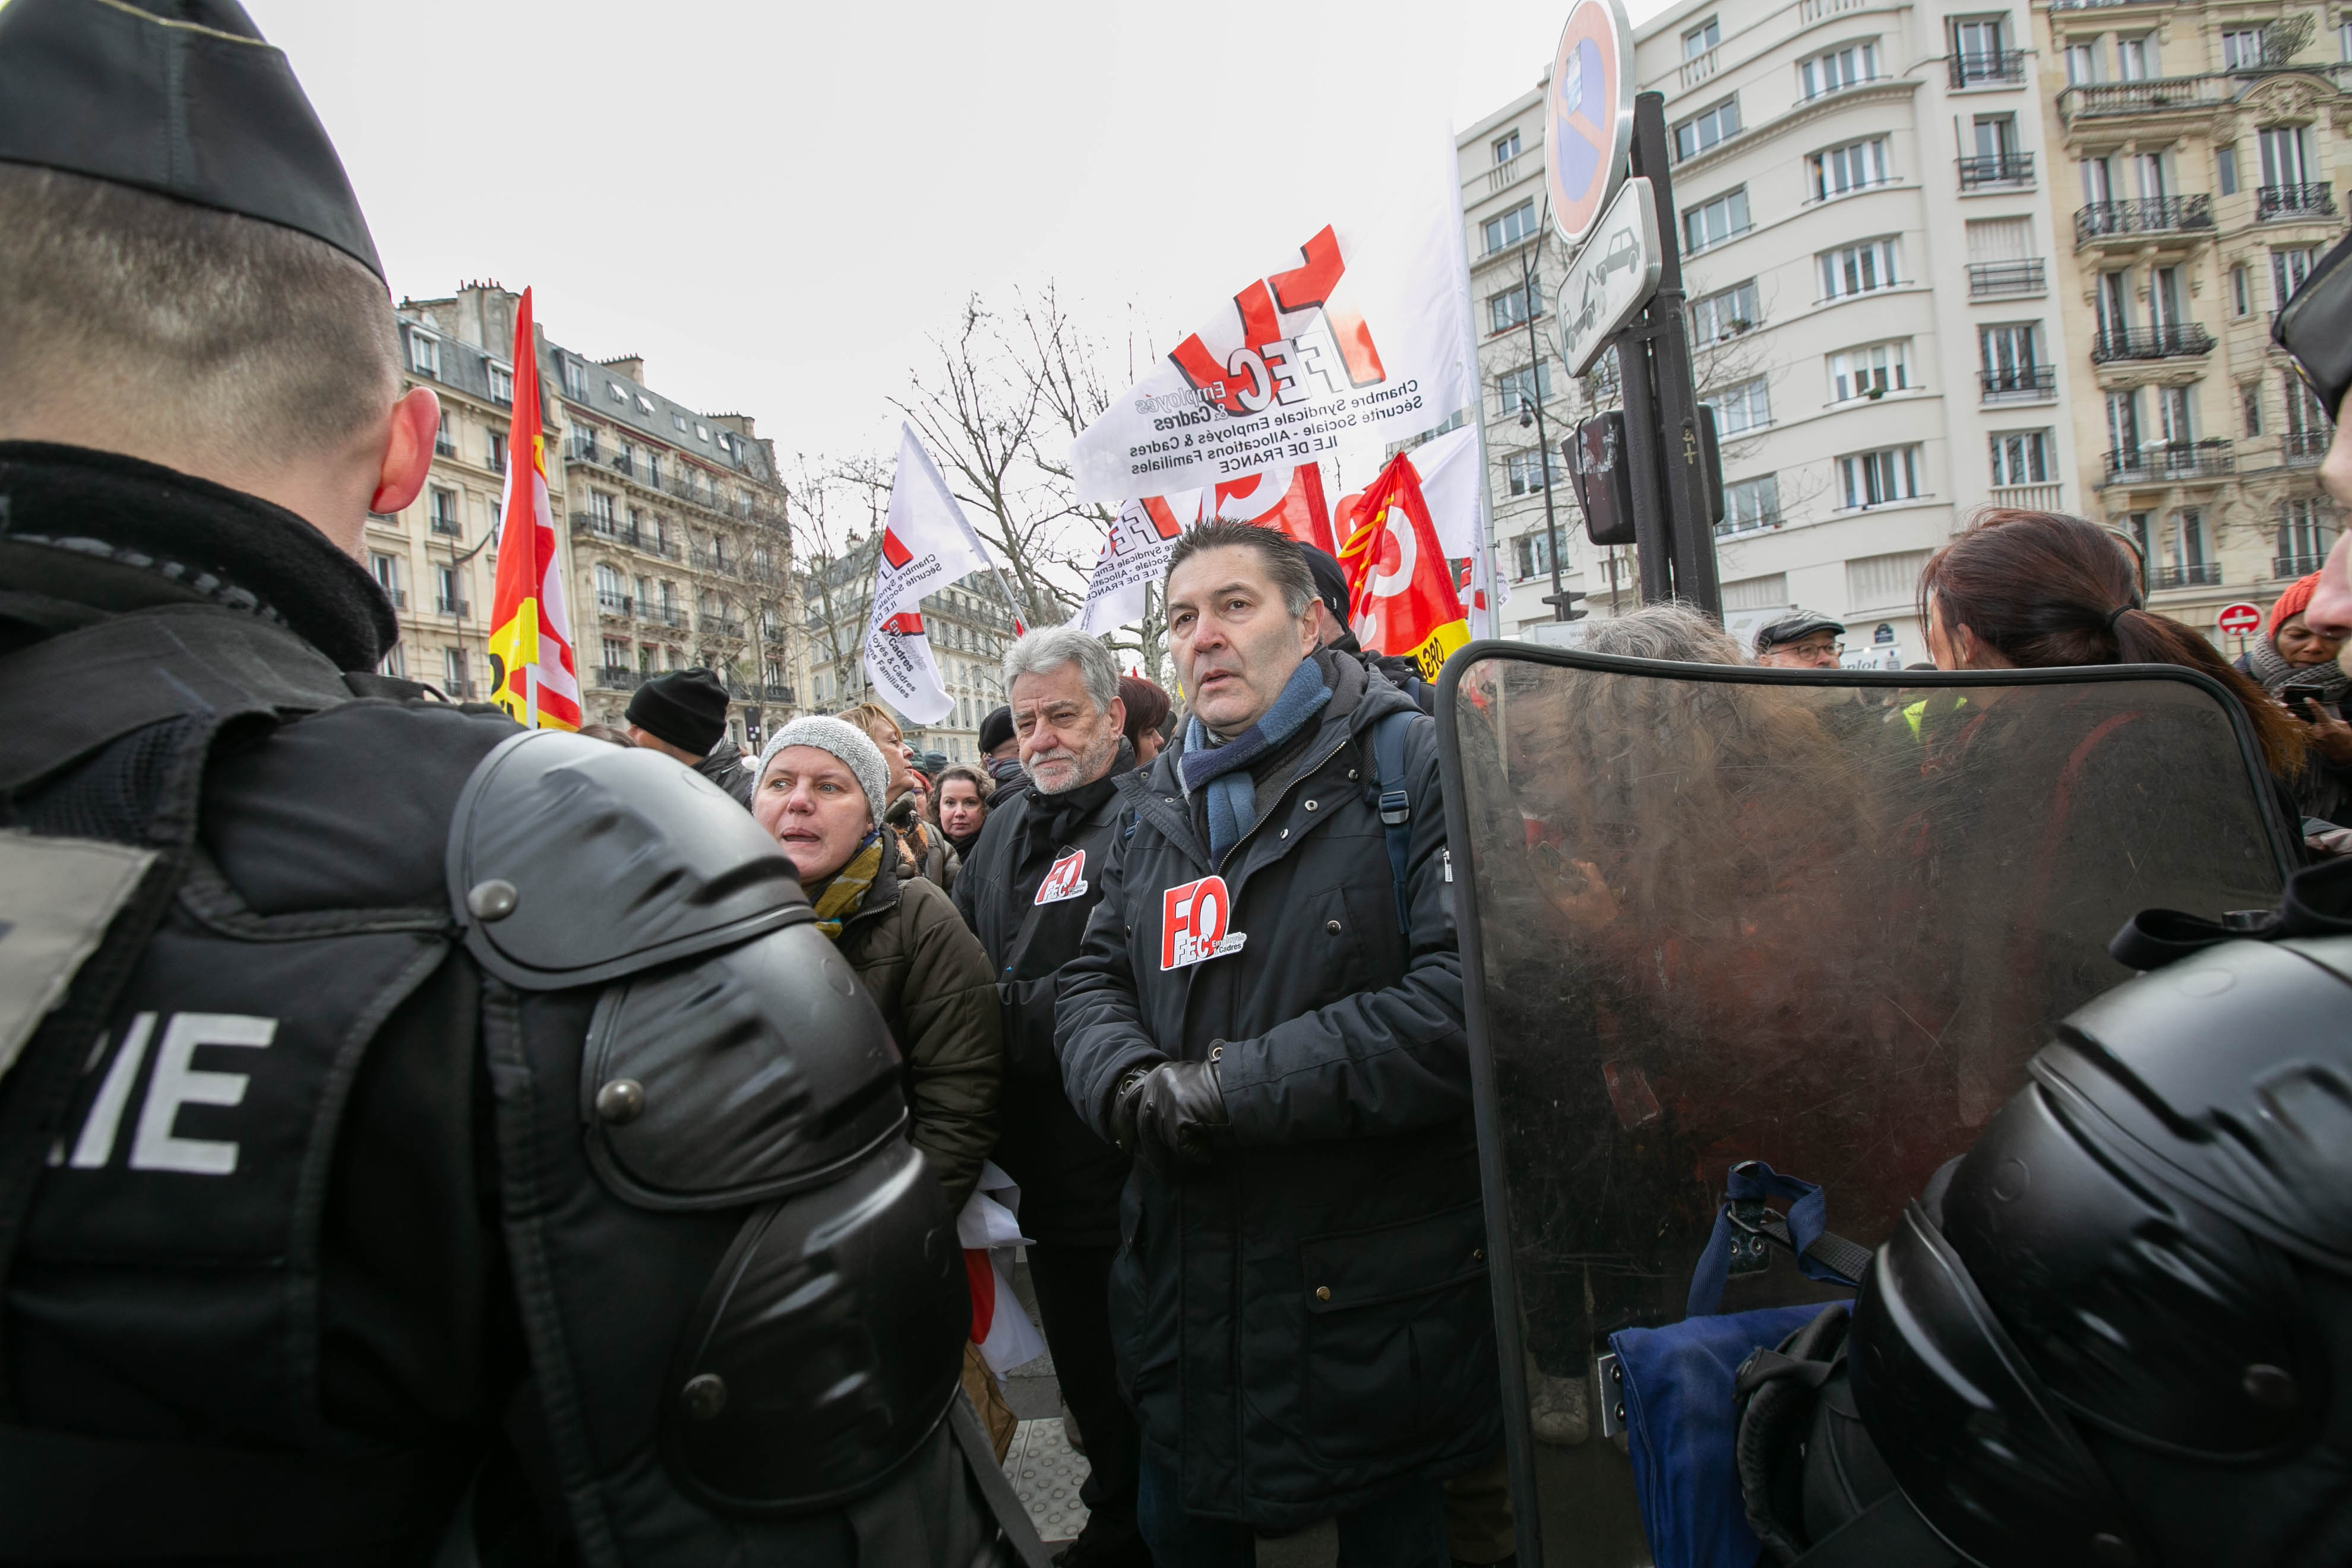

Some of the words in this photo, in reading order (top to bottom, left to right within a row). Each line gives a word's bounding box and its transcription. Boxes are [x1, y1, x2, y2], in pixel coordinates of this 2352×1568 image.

[889, 637, 914, 672] Cadres
[875, 659, 910, 698] Familiales
[893, 664, 917, 692] Cadres
[1036, 851, 1084, 903] FO
[1044, 881, 1067, 902] FEC
[1162, 877, 1228, 968] FO
[1174, 932, 1210, 965] FEC
[1219, 943, 1242, 954] Cadres
